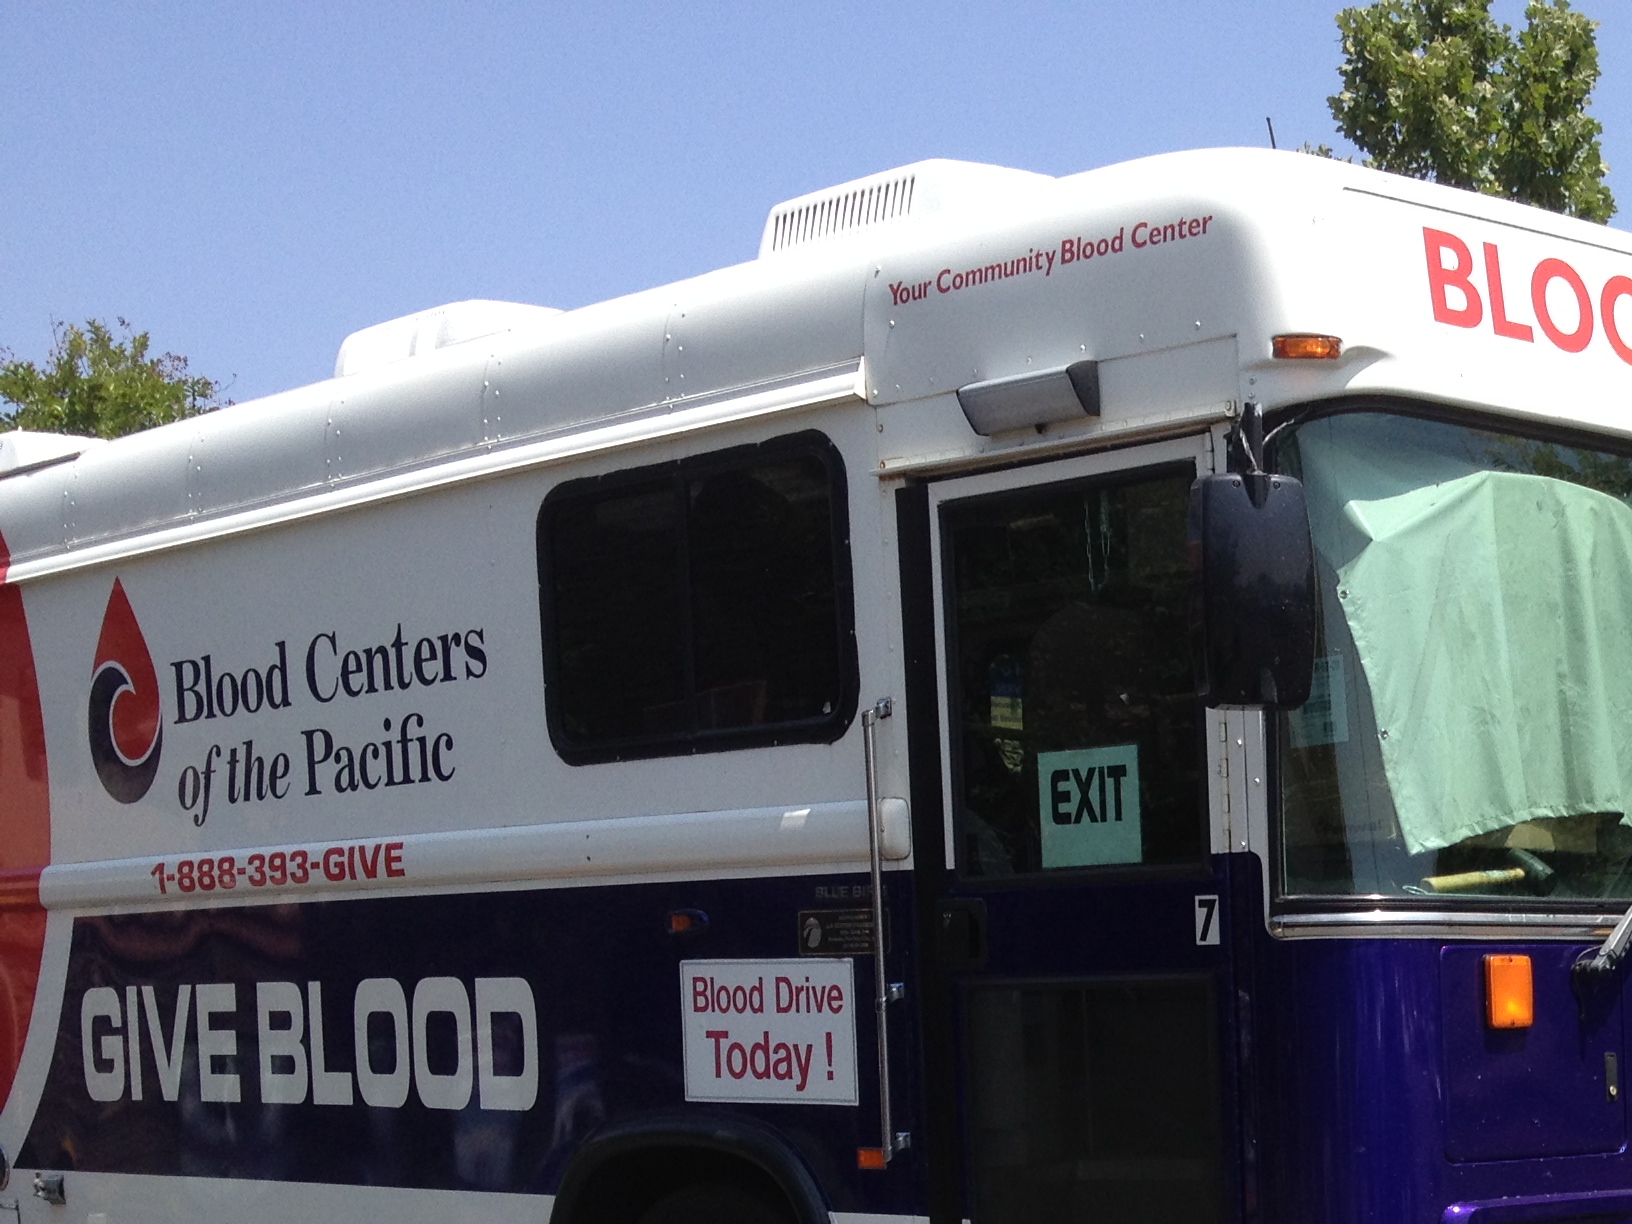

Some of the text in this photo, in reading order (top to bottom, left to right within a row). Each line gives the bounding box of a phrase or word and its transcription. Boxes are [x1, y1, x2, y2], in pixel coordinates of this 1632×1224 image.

[888, 214, 1213, 306] Your Community Blood Center
[170, 622, 488, 725] Blood Centers
[178, 712, 457, 827] of the Pacific
[1050, 763, 1127, 826] EXIT
[151, 842, 406, 895] 1-888-393-GIVE
[1198, 898, 1218, 942] 7
[691, 975, 844, 1016] Blood Drive
[81, 976, 539, 1112] GIVE BLOOD
[705, 1030, 813, 1091] Today
